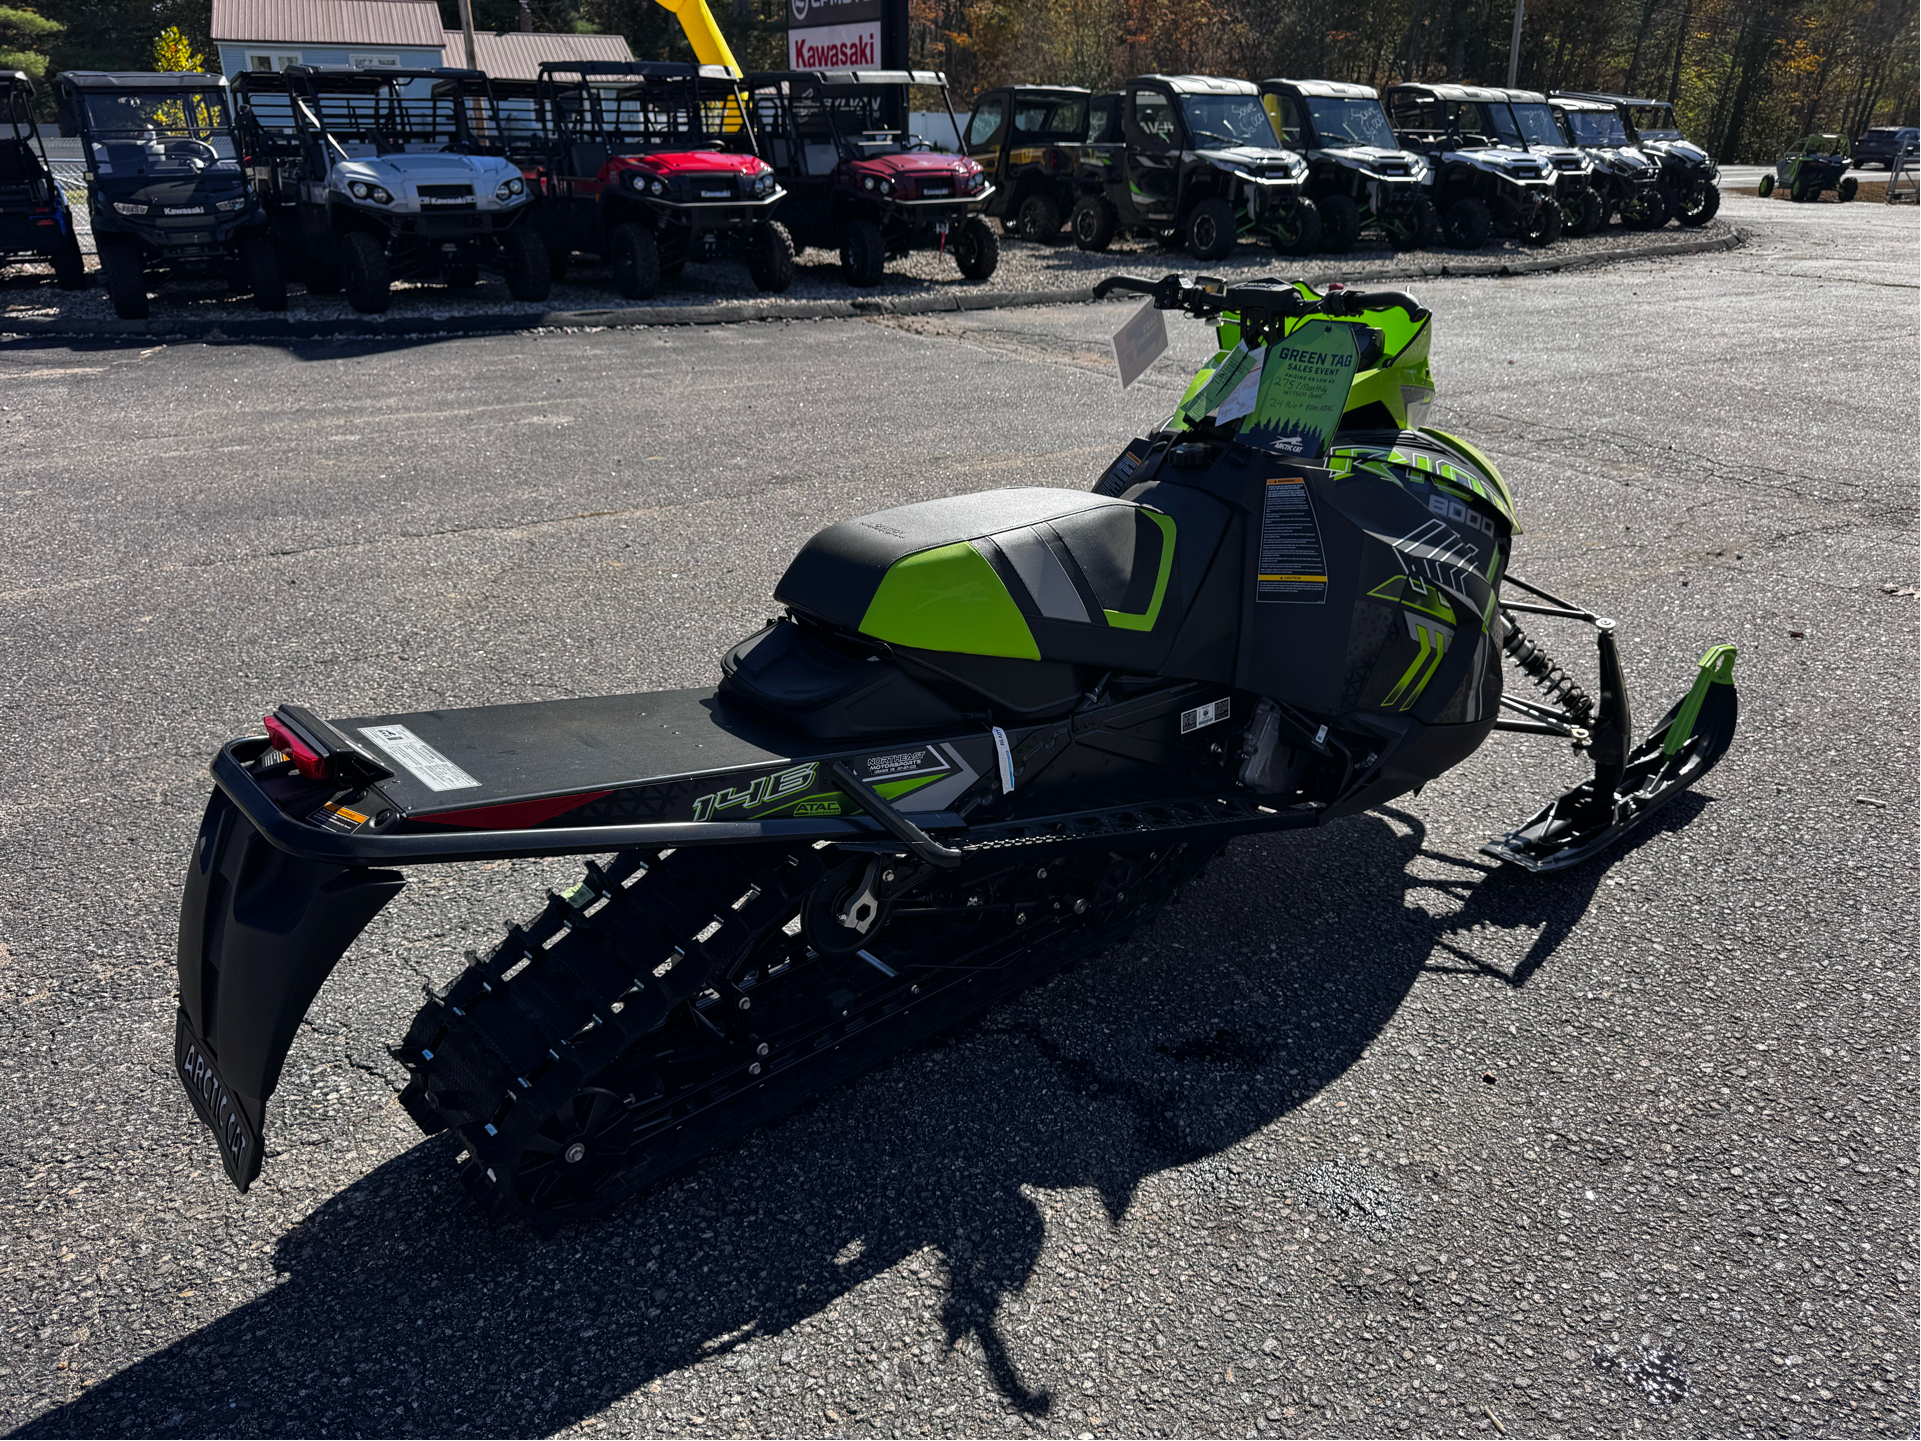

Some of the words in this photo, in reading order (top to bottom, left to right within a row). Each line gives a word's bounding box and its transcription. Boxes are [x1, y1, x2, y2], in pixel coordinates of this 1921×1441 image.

[795, 33, 874, 68] Kawasaki
[1231, 102, 1257, 120] Save
[431, 197, 466, 205] Kawasaki
[164, 206, 204, 215] Kawasaki
[1279, 347, 1328, 365] GREEN
[1330, 354, 1353, 367] TAG
[1287, 363, 1313, 373] SALES
[1315, 366, 1340, 376] EVENT
[1285, 373, 1307, 381] PRICING
[1274, 442, 1293, 451] ARCTIC
[1292, 445, 1304, 453] CAT
[1429, 494, 1495, 537] 8000
[868, 751, 926, 767] NORTHEAST
[870, 760, 921, 770] MOTORSPORTS
[692, 761, 820, 822] 146
[797, 802, 841, 812] ATAC
[184, 1044, 227, 1127] ARCTIC
[227, 1112, 246, 1166] CAT
